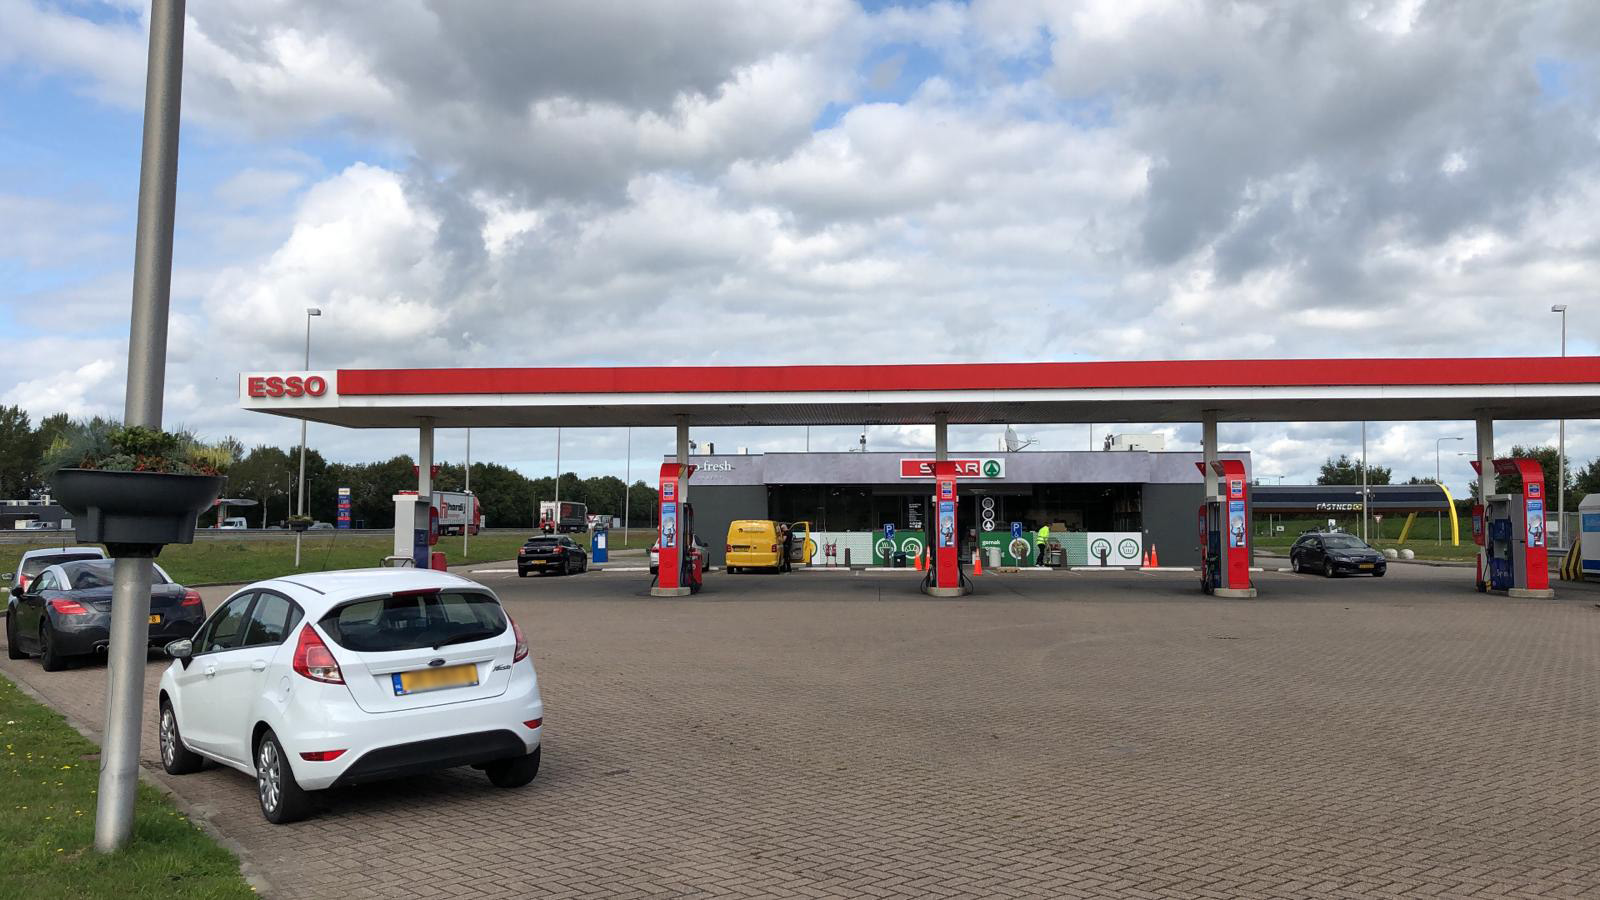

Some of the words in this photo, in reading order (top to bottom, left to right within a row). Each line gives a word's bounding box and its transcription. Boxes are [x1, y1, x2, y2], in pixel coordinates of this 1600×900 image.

[248, 376, 327, 397] ESSO
[703, 460, 732, 471] fresh
[919, 463, 978, 473] SAR
[886, 525, 893, 533] P
[1013, 523, 1020, 532] P
